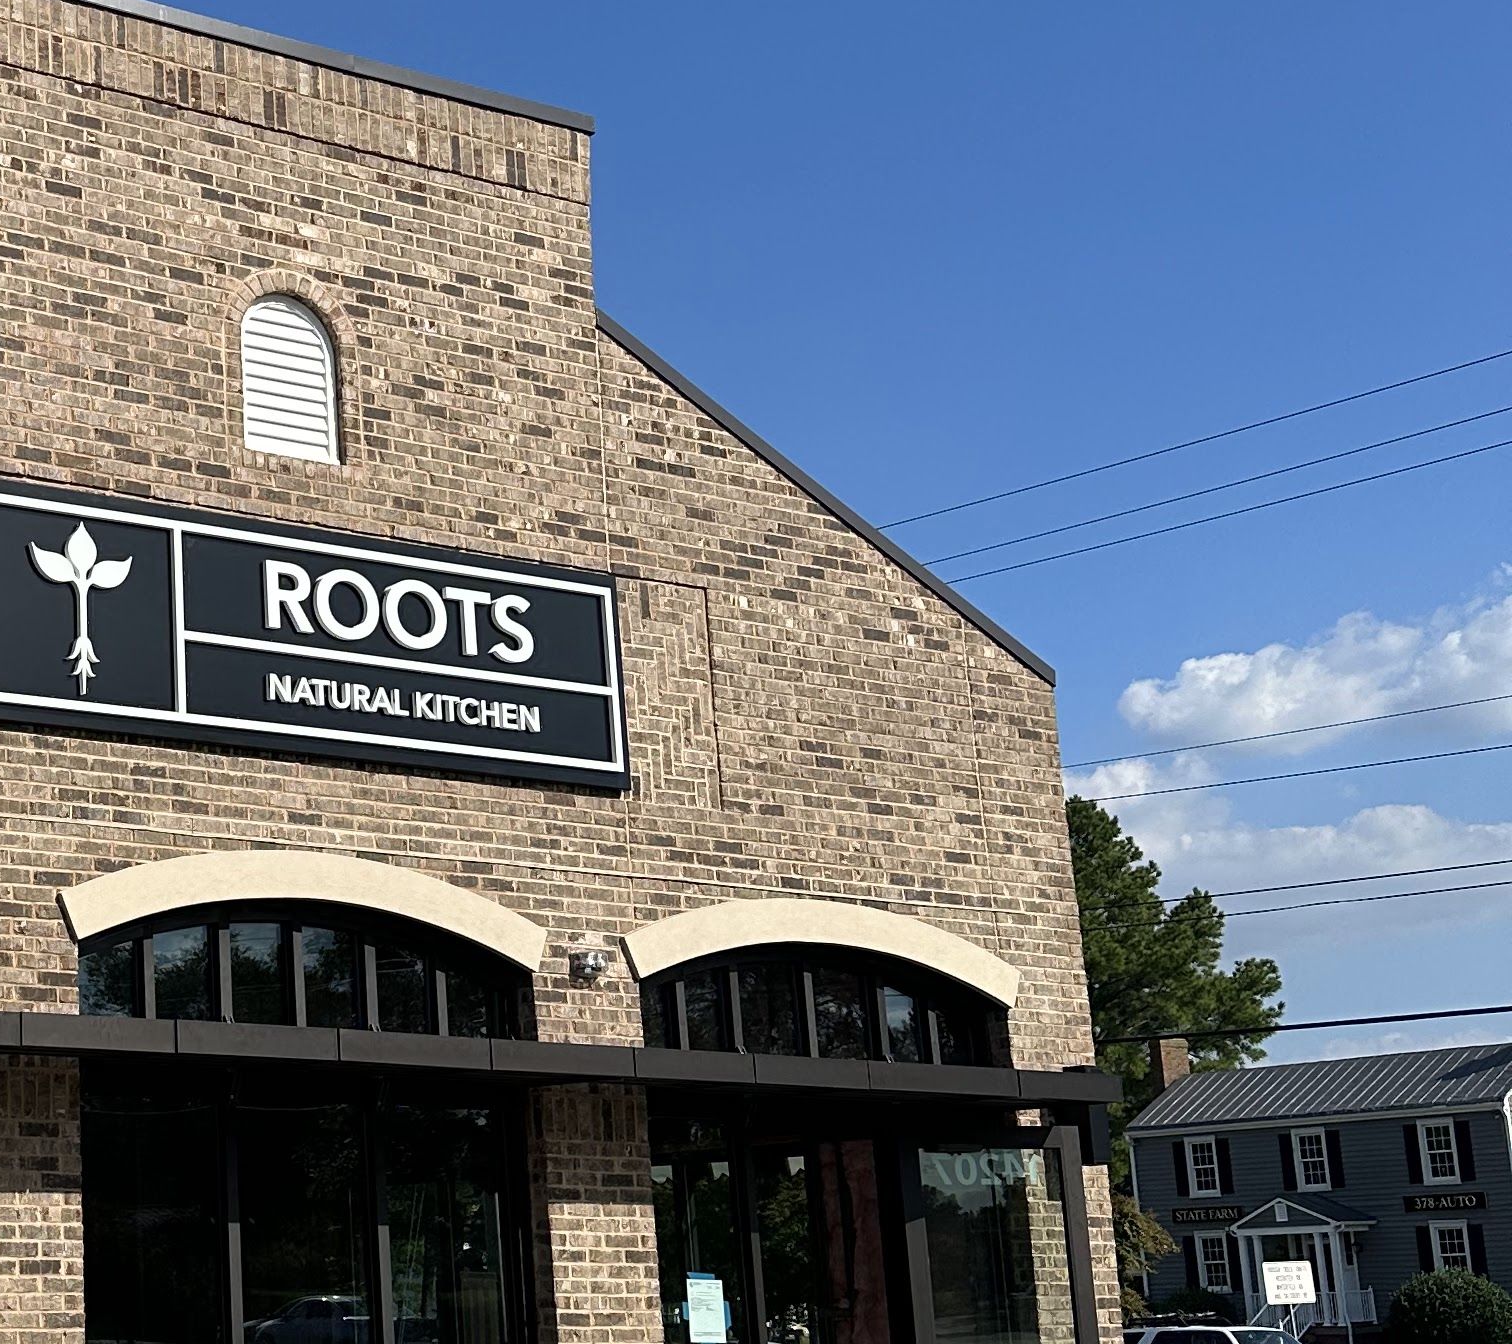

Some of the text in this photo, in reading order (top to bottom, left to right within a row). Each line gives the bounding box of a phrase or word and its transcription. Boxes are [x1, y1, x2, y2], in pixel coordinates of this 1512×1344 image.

[262, 559, 535, 663] ROOTS
[266, 672, 541, 733] NATURAL KITCHEN
[1175, 1208, 1239, 1222] STATE FARM
[1414, 1195, 1476, 1210] 378-AUTO
